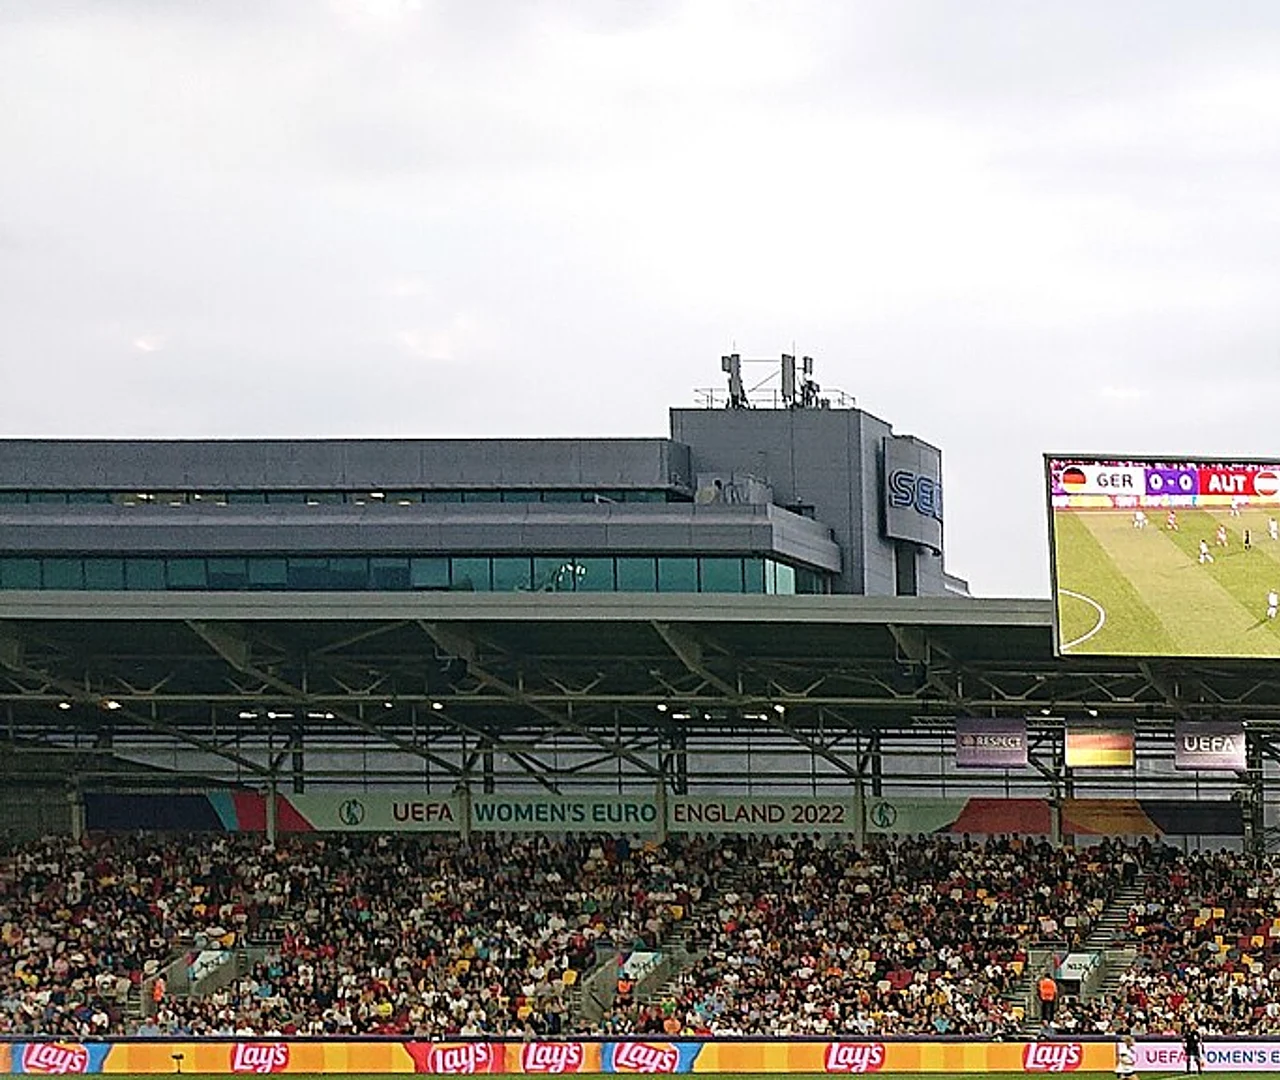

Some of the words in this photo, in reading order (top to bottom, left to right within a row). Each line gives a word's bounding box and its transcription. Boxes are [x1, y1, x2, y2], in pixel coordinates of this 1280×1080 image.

[889, 466, 942, 519] SE
[1096, 473, 1133, 489] GER
[1208, 473, 1247, 493] AUT
[1184, 736, 1235, 752] UEFA
[393, 802, 454, 822] UEFA
[474, 803, 585, 823] WOMEN'S
[592, 803, 657, 823] EURO
[674, 803, 785, 823] ENGLAND
[791, 804, 845, 824] 2022
[233, 1042, 287, 1073] Lay's
[524, 1042, 580, 1073] Lay's
[827, 1042, 883, 1073] Lay's
[1024, 1042, 1080, 1072] Lay's
[1206, 1050, 1267, 1064] OMEN'S
